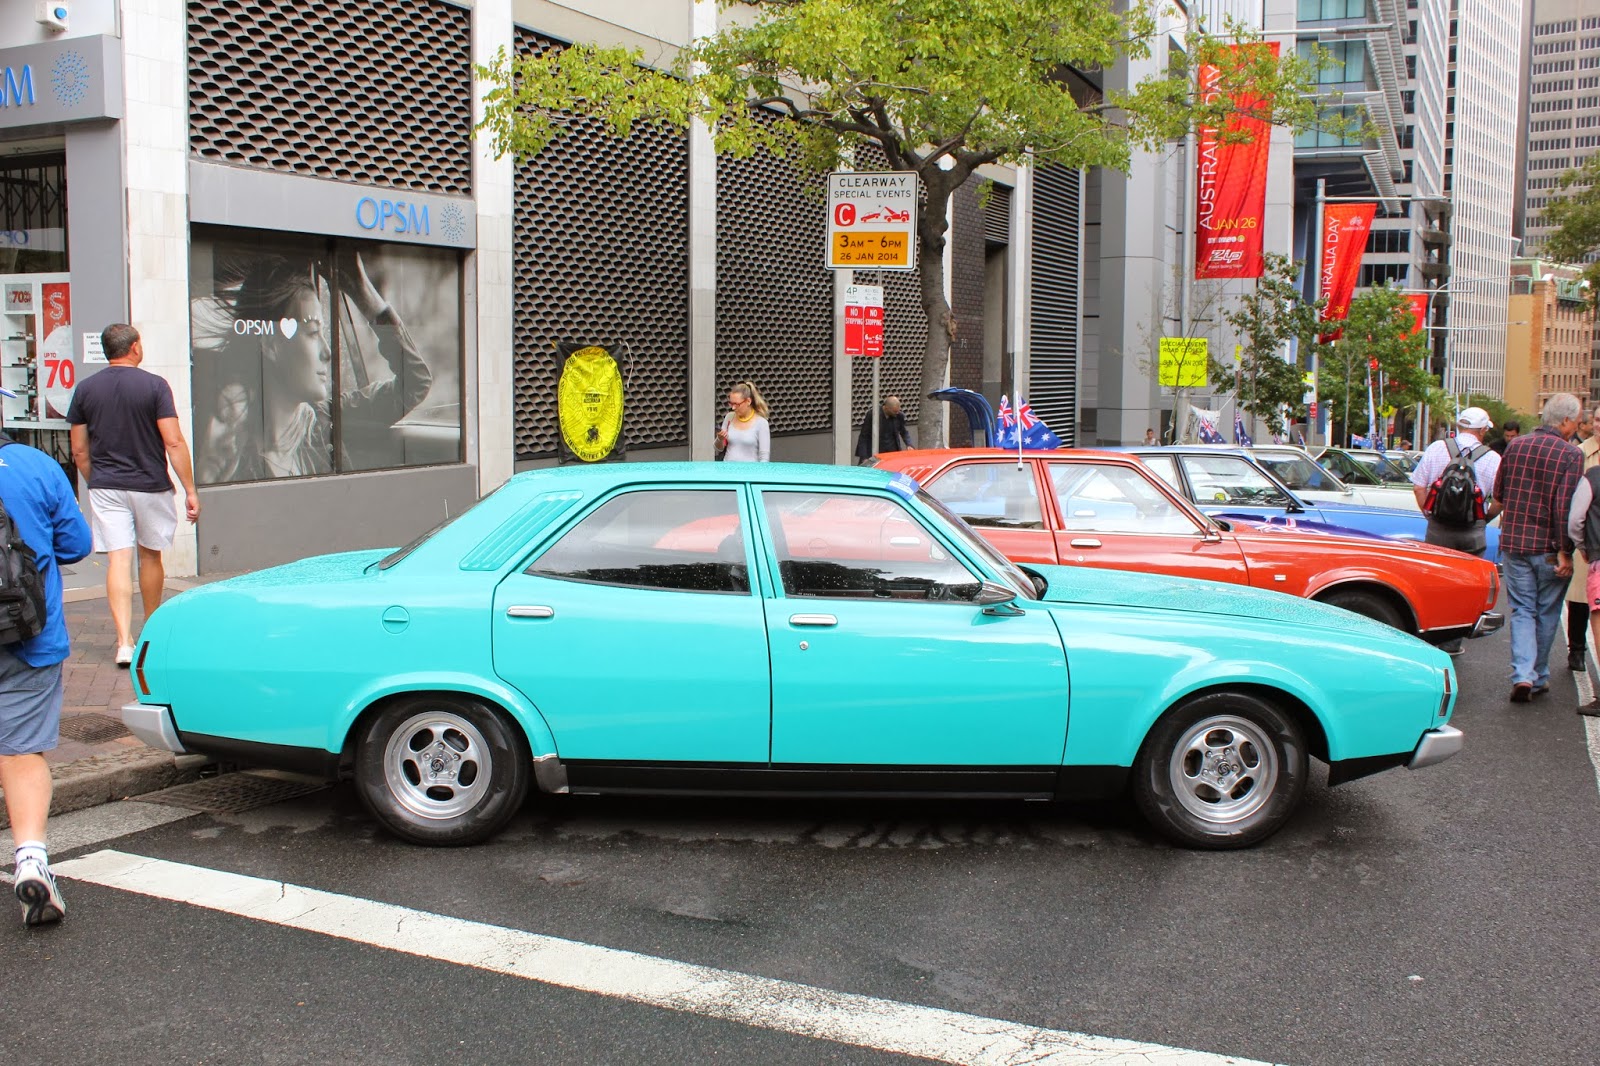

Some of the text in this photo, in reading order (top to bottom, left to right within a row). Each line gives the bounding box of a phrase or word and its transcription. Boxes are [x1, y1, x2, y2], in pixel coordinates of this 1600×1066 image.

[839, 177, 906, 188] CLEARWAY
[834, 190, 911, 198] SPECIAL EVENTS
[356, 196, 431, 235] OPSM
[838, 205, 851, 225] C
[1213, 217, 1256, 230] JAN 26
[1327, 216, 1341, 244] DAY
[840, 235, 864, 248] 3AM
[880, 236, 902, 248] 6PM
[846, 287, 858, 295] 4P
[850, 308, 858, 317] NO
[869, 309, 878, 317] NO
[845, 317, 863, 325] STOPPING
[865, 318, 882, 326] STOPPING
[233, 319, 274, 336] OPSM
[44, 358, 75, 390] 70
